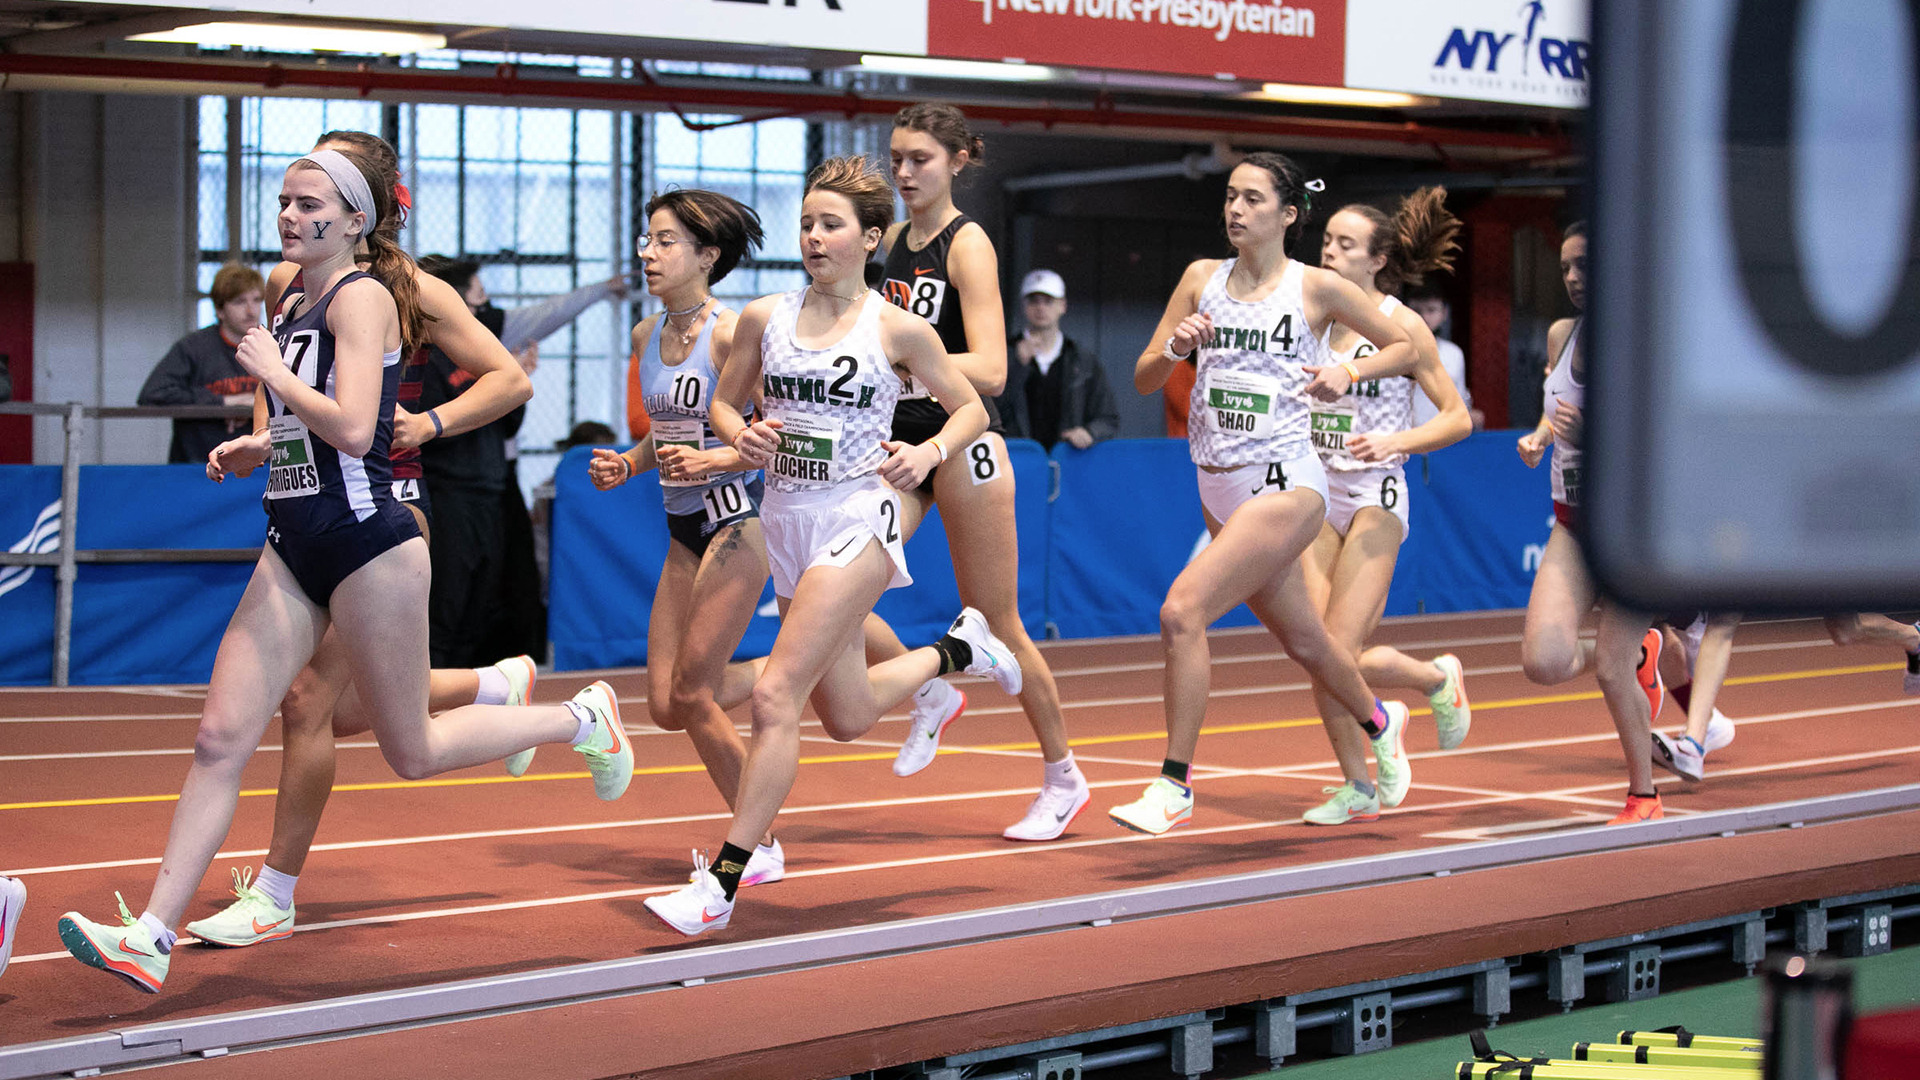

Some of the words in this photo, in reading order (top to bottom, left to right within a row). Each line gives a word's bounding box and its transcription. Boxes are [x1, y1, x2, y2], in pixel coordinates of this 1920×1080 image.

[997, 0, 1316, 41] work-Presbyterian
[313, 221, 332, 240] Y
[912, 282, 937, 319] 8
[1271, 314, 1294, 351] 4
[291, 335, 312, 377] 7
[674, 374, 700, 409] 10
[764, 374, 876, 409] ARTMOH
[828, 355, 858, 399] 2
[1223, 392, 1243, 408] Ivy
[1217, 410, 1256, 432] CHAO
[784, 435, 804, 454] Ivy
[971, 443, 995, 480] 8
[774, 453, 829, 481] LOCHER
[1265, 461, 1288, 491] 4
[705, 482, 741, 519] 10
[1380, 475, 1398, 509] 6
[880, 499, 898, 544] 2
